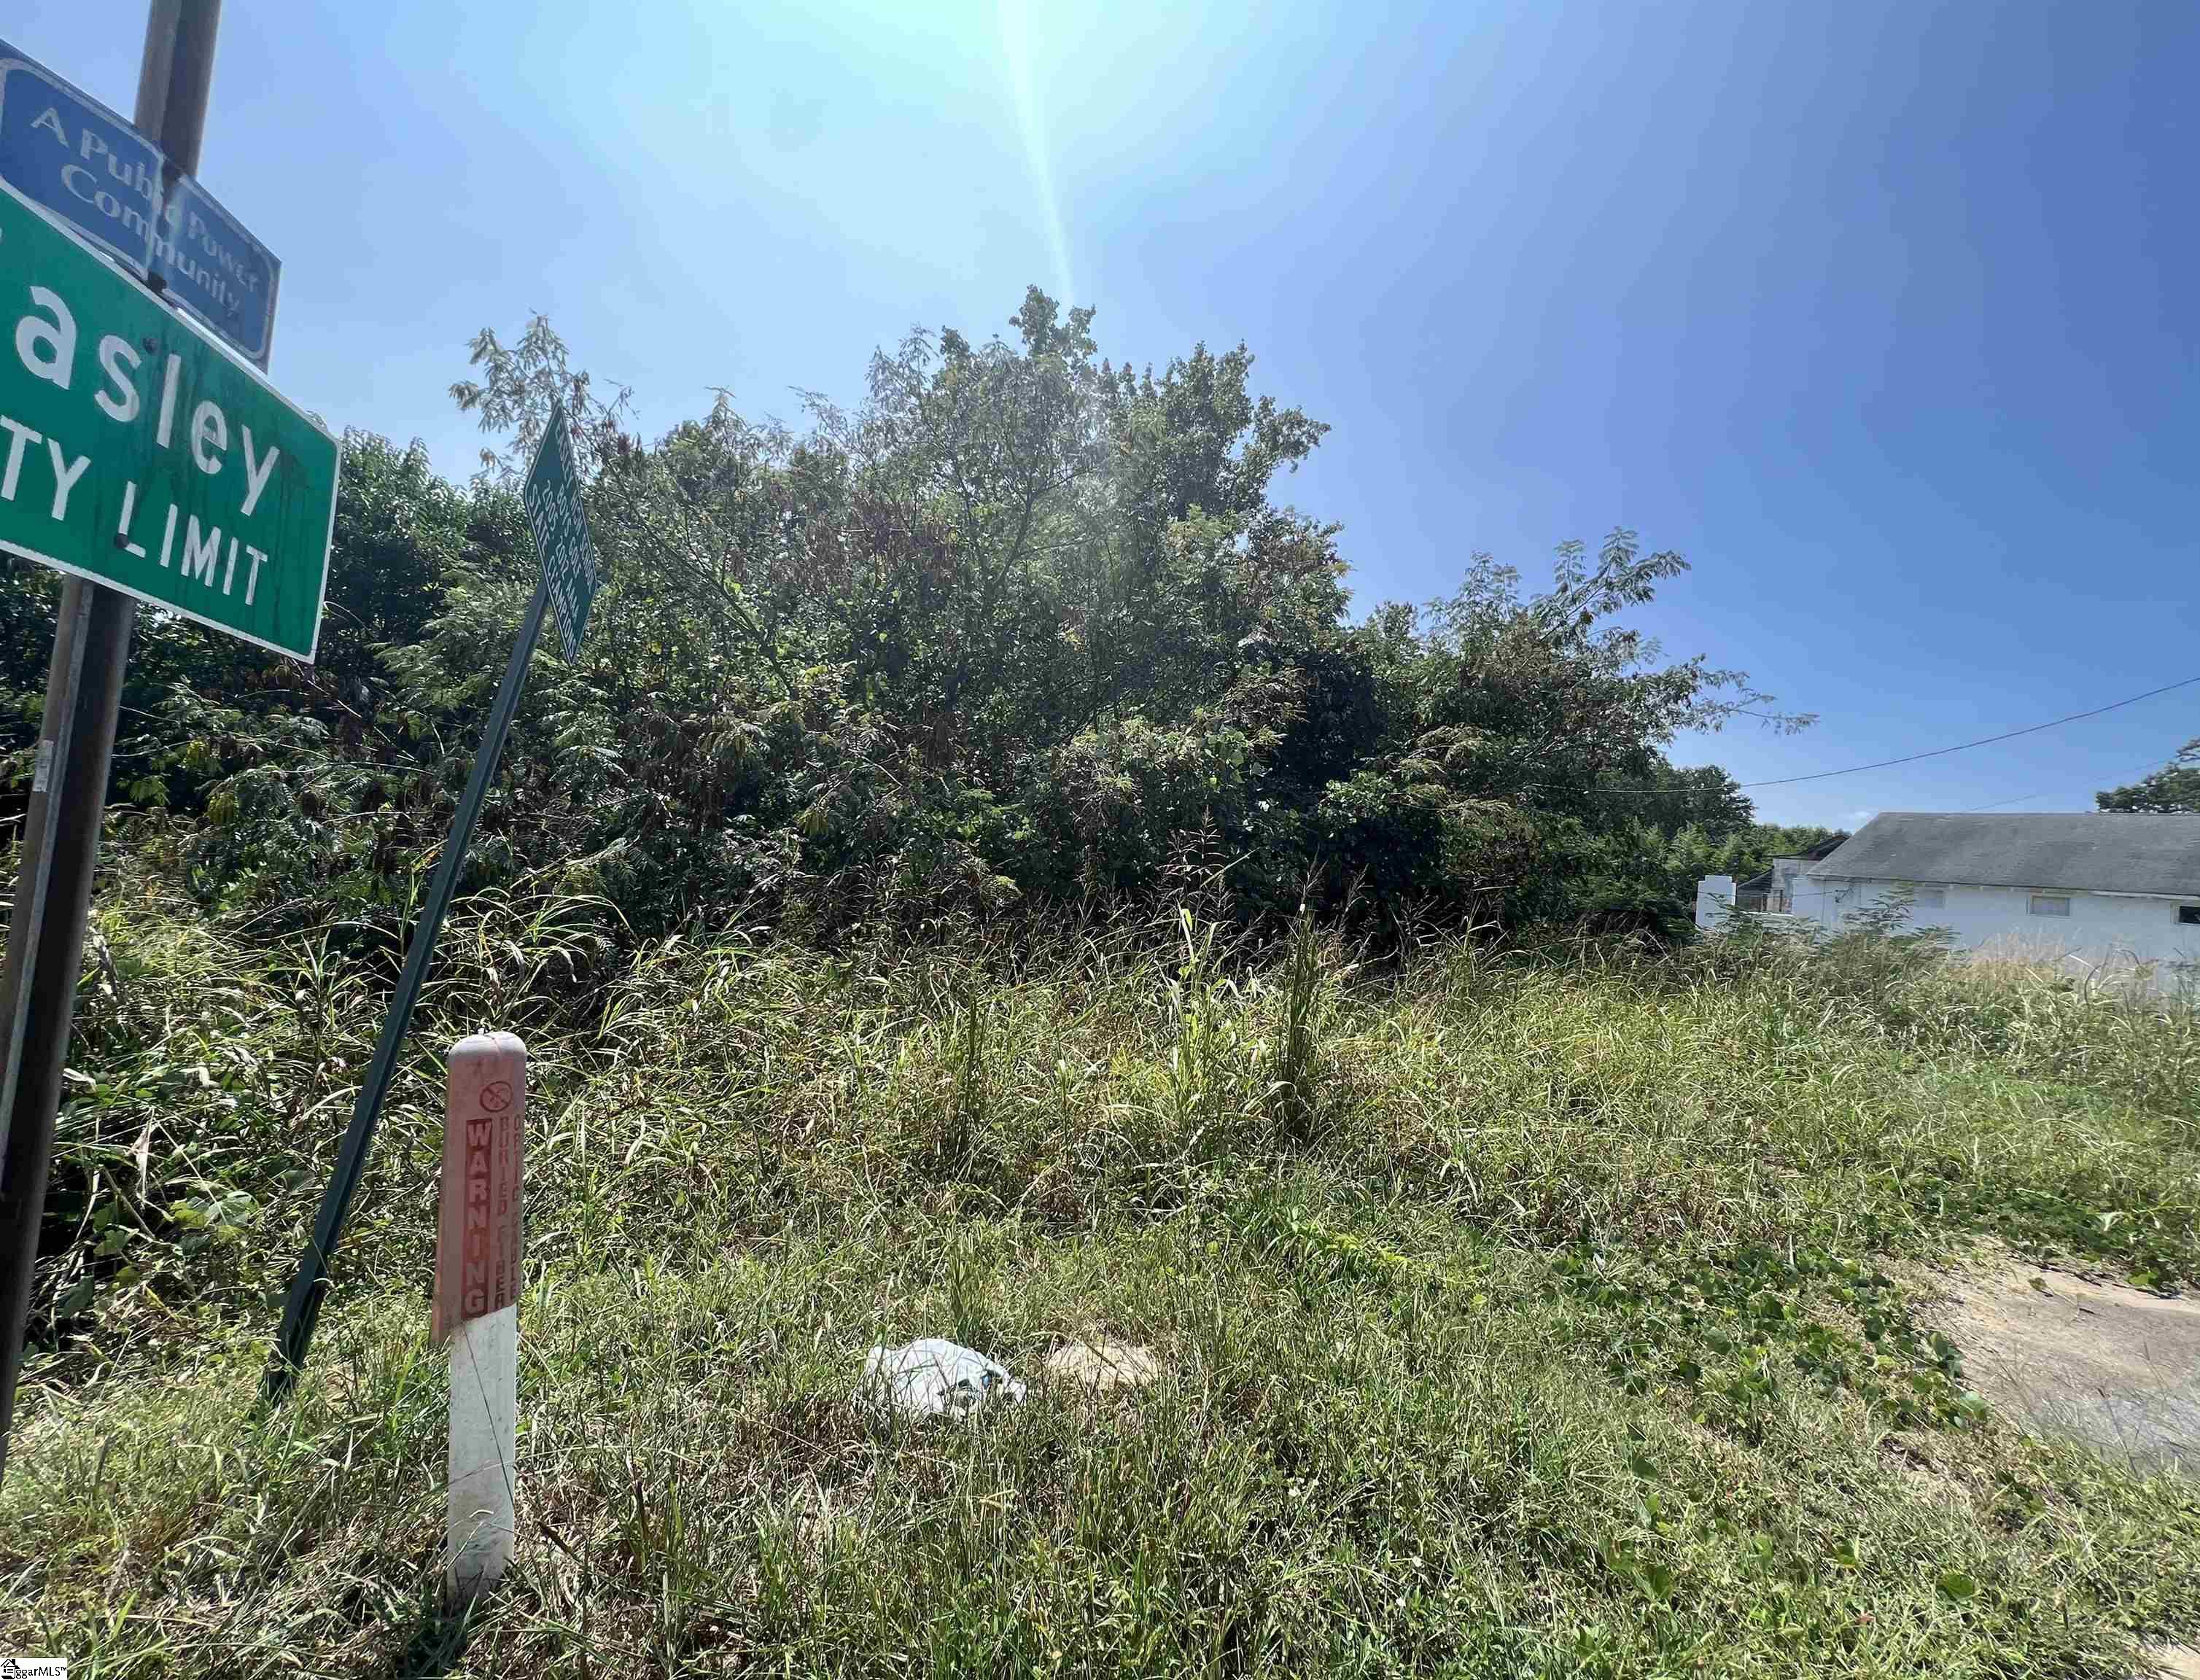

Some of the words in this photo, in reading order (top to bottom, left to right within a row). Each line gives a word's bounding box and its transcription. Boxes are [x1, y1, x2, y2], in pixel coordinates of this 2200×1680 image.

[31, 107, 69, 149] A
[80, 128, 177, 228] Pubc
[61, 163, 241, 318] Community
[0, 225, 280, 517] asley
[115, 480, 268, 607] LIMIT
[529, 483, 550, 556] STATE
[548, 556, 577, 657] CHAMPIONS
[556, 535, 569, 580] 2012
[557, 483, 572, 537] BOYS
[569, 537, 582, 578] GOLF
[465, 1121, 492, 1313] WARNING
